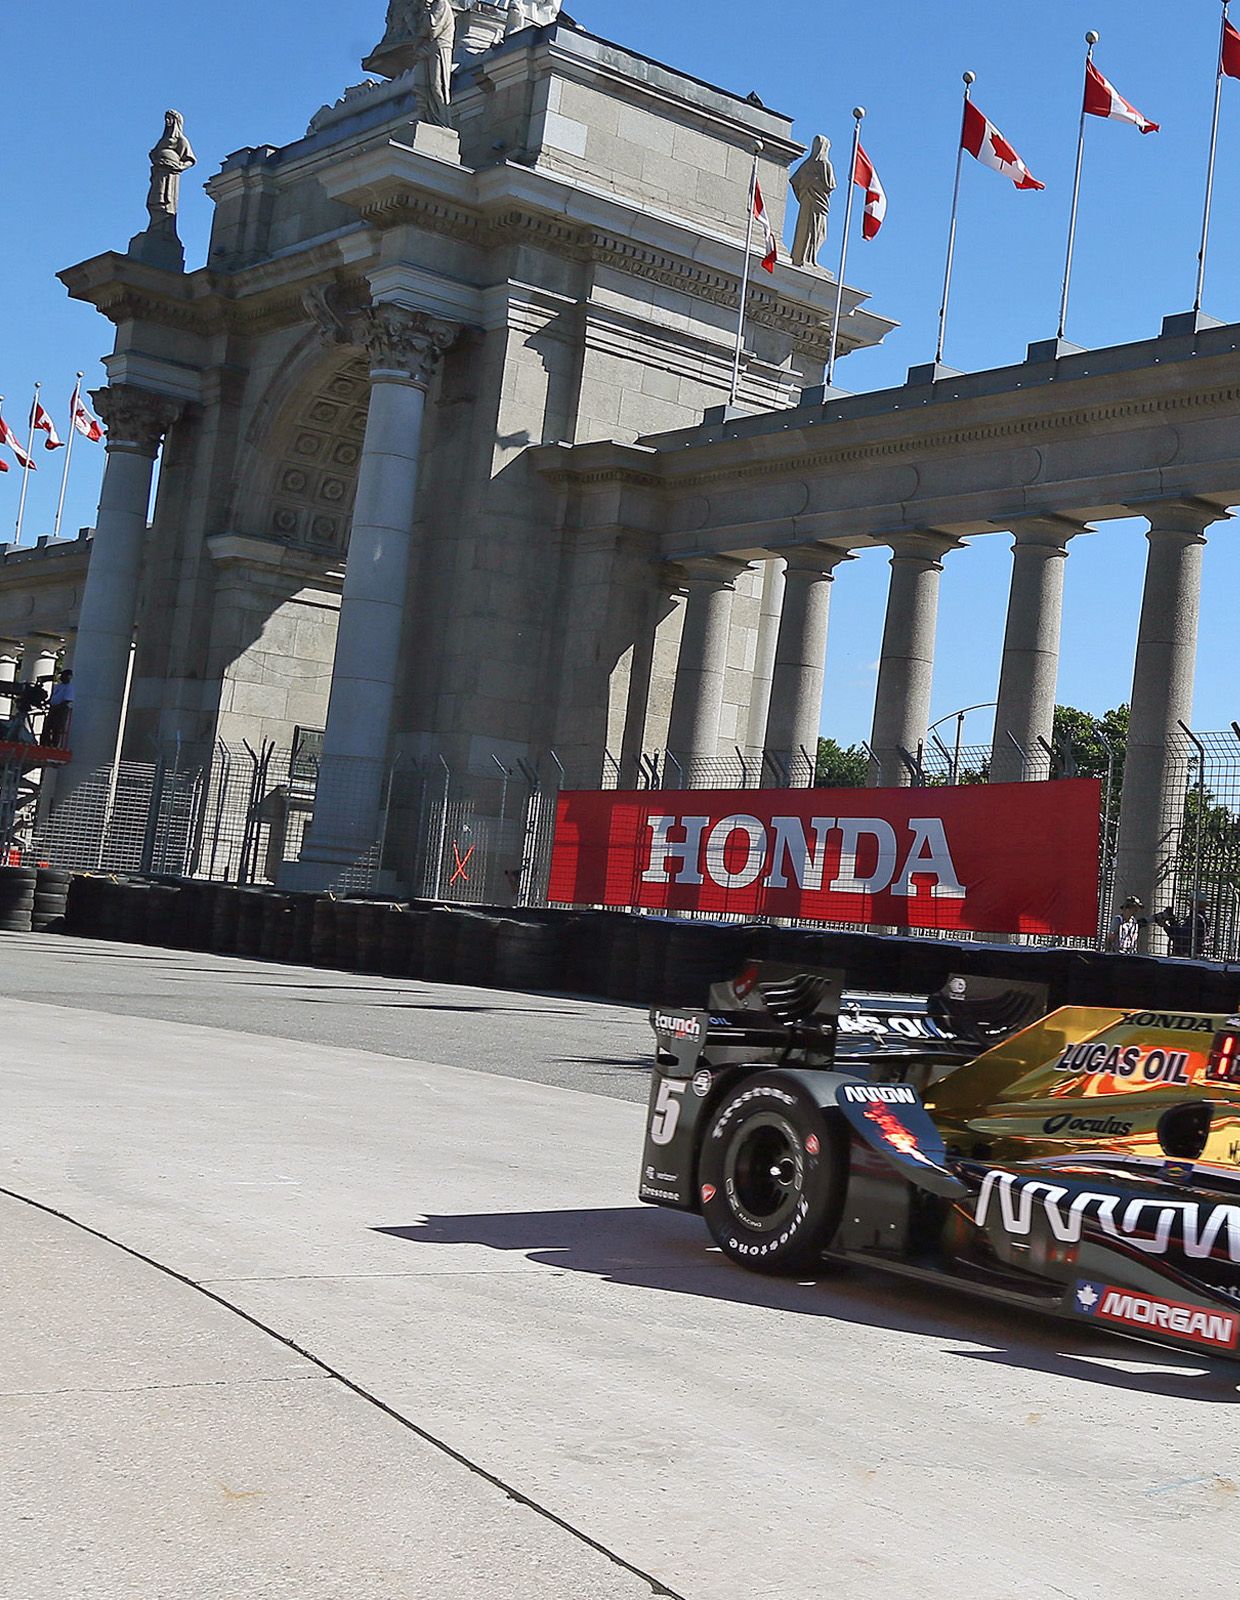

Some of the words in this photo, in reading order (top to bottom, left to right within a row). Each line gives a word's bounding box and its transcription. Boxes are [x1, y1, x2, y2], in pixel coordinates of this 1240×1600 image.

[642, 814, 966, 899] HONDA
[1120, 1010, 1215, 1033] HONDA
[1055, 1043, 1140, 1077] LUCAS
[1143, 1048, 1190, 1086] OIL
[651, 1078, 688, 1146] 5
[1068, 1114, 1134, 1136] oculus
[1102, 1291, 1233, 1343] MORGAN
